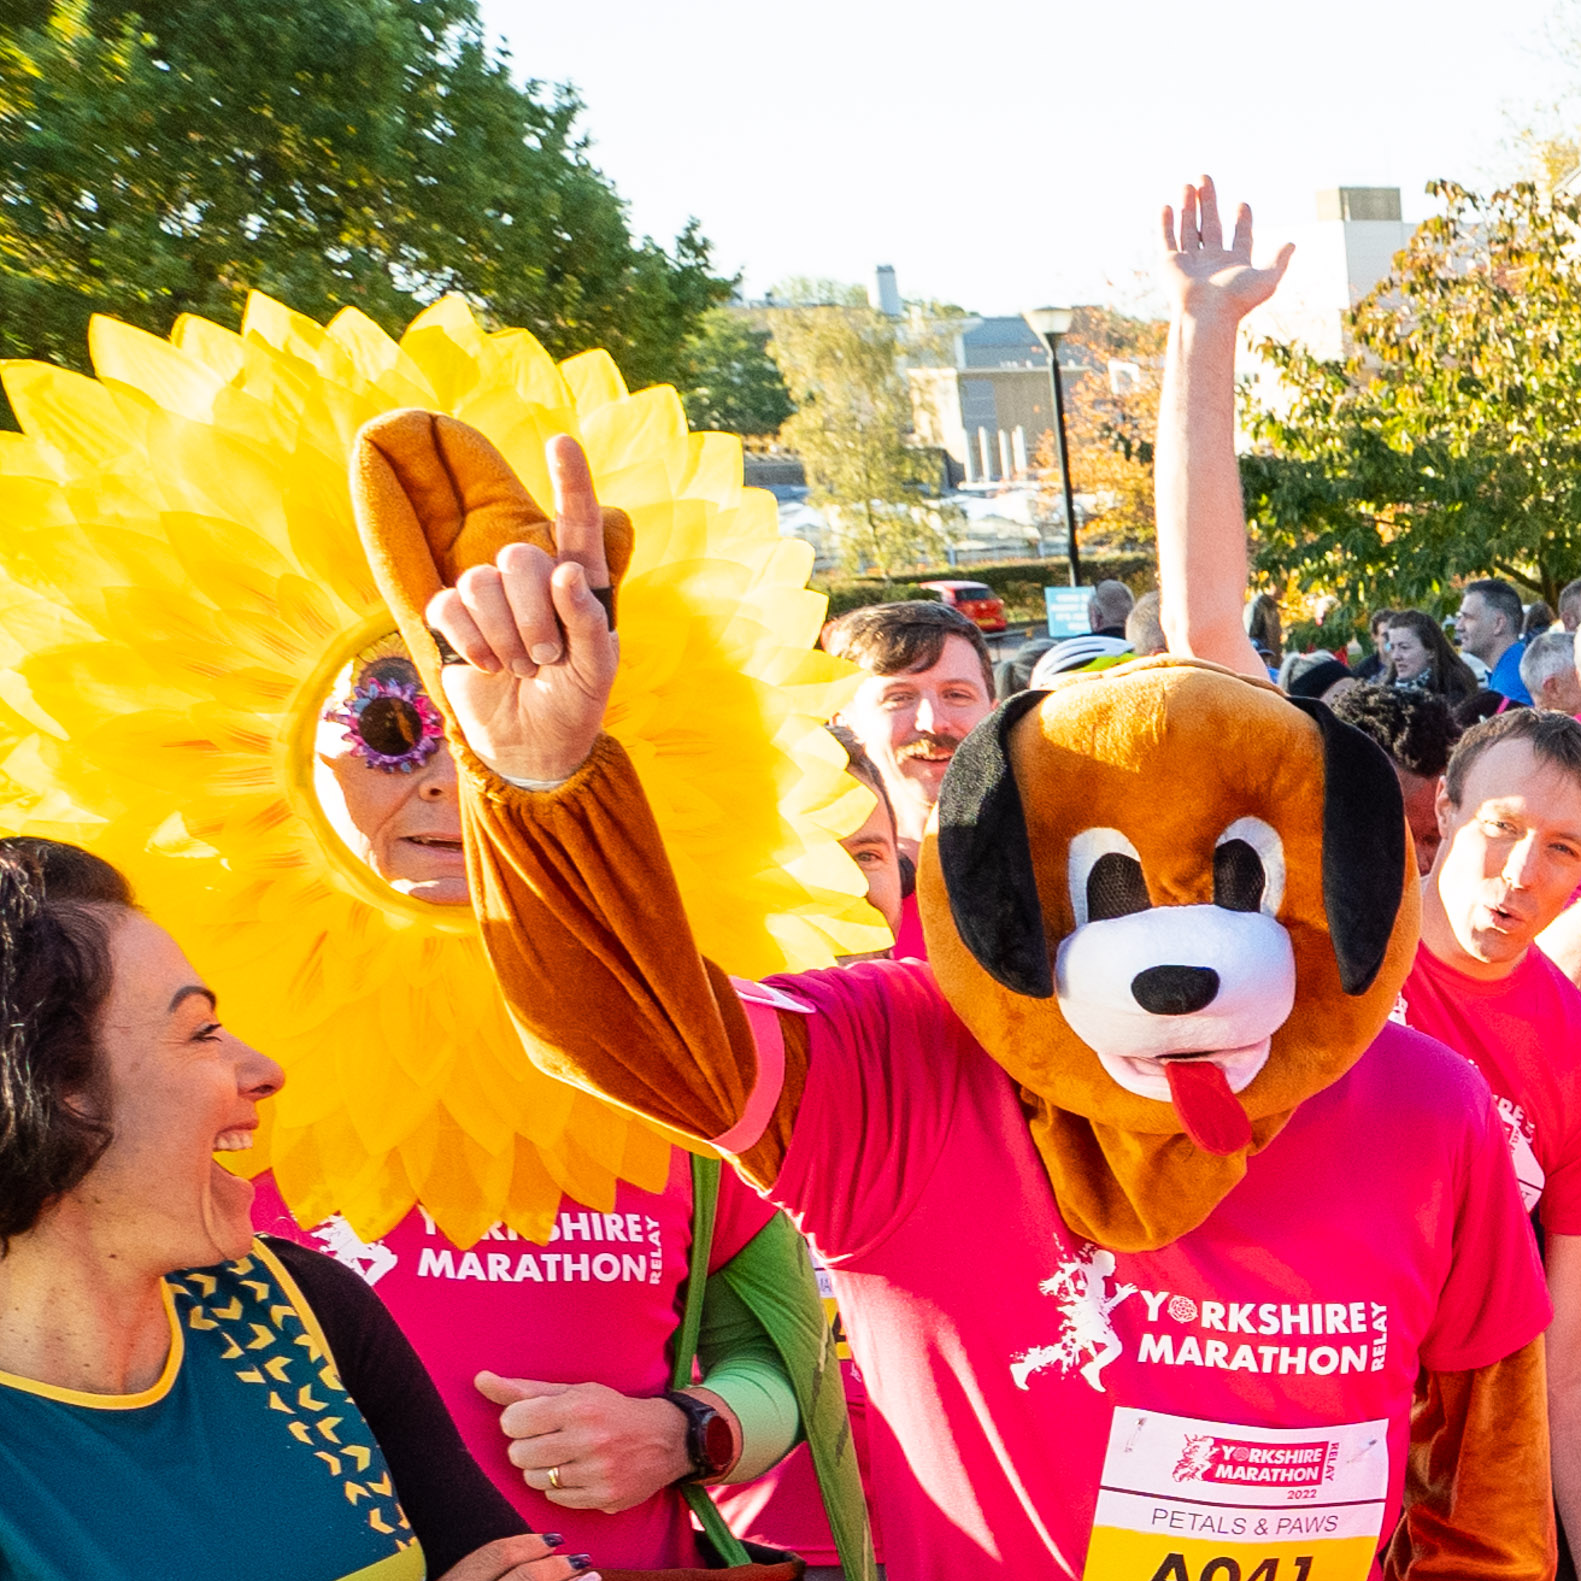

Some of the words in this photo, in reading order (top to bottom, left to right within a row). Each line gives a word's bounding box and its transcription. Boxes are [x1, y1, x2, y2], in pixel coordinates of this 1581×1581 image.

[417, 1247, 647, 1283] MARATHON
[645, 1215, 663, 1285] RELAY
[1138, 1288, 1368, 1334] YORKSHIRE
[1137, 1333, 1369, 1375] MARATHON
[1369, 1300, 1388, 1372] RELAY
[1214, 1462, 1320, 1483] MARATHON
[1219, 1443, 1324, 1464] YORKSHIRE
[1325, 1440, 1340, 1483] RELAY
[1286, 1489, 1318, 1500] 2022
[1151, 1506, 1248, 1536] PETALS
[1256, 1514, 1270, 1535] &
[1275, 1513, 1340, 1535] PAWS
